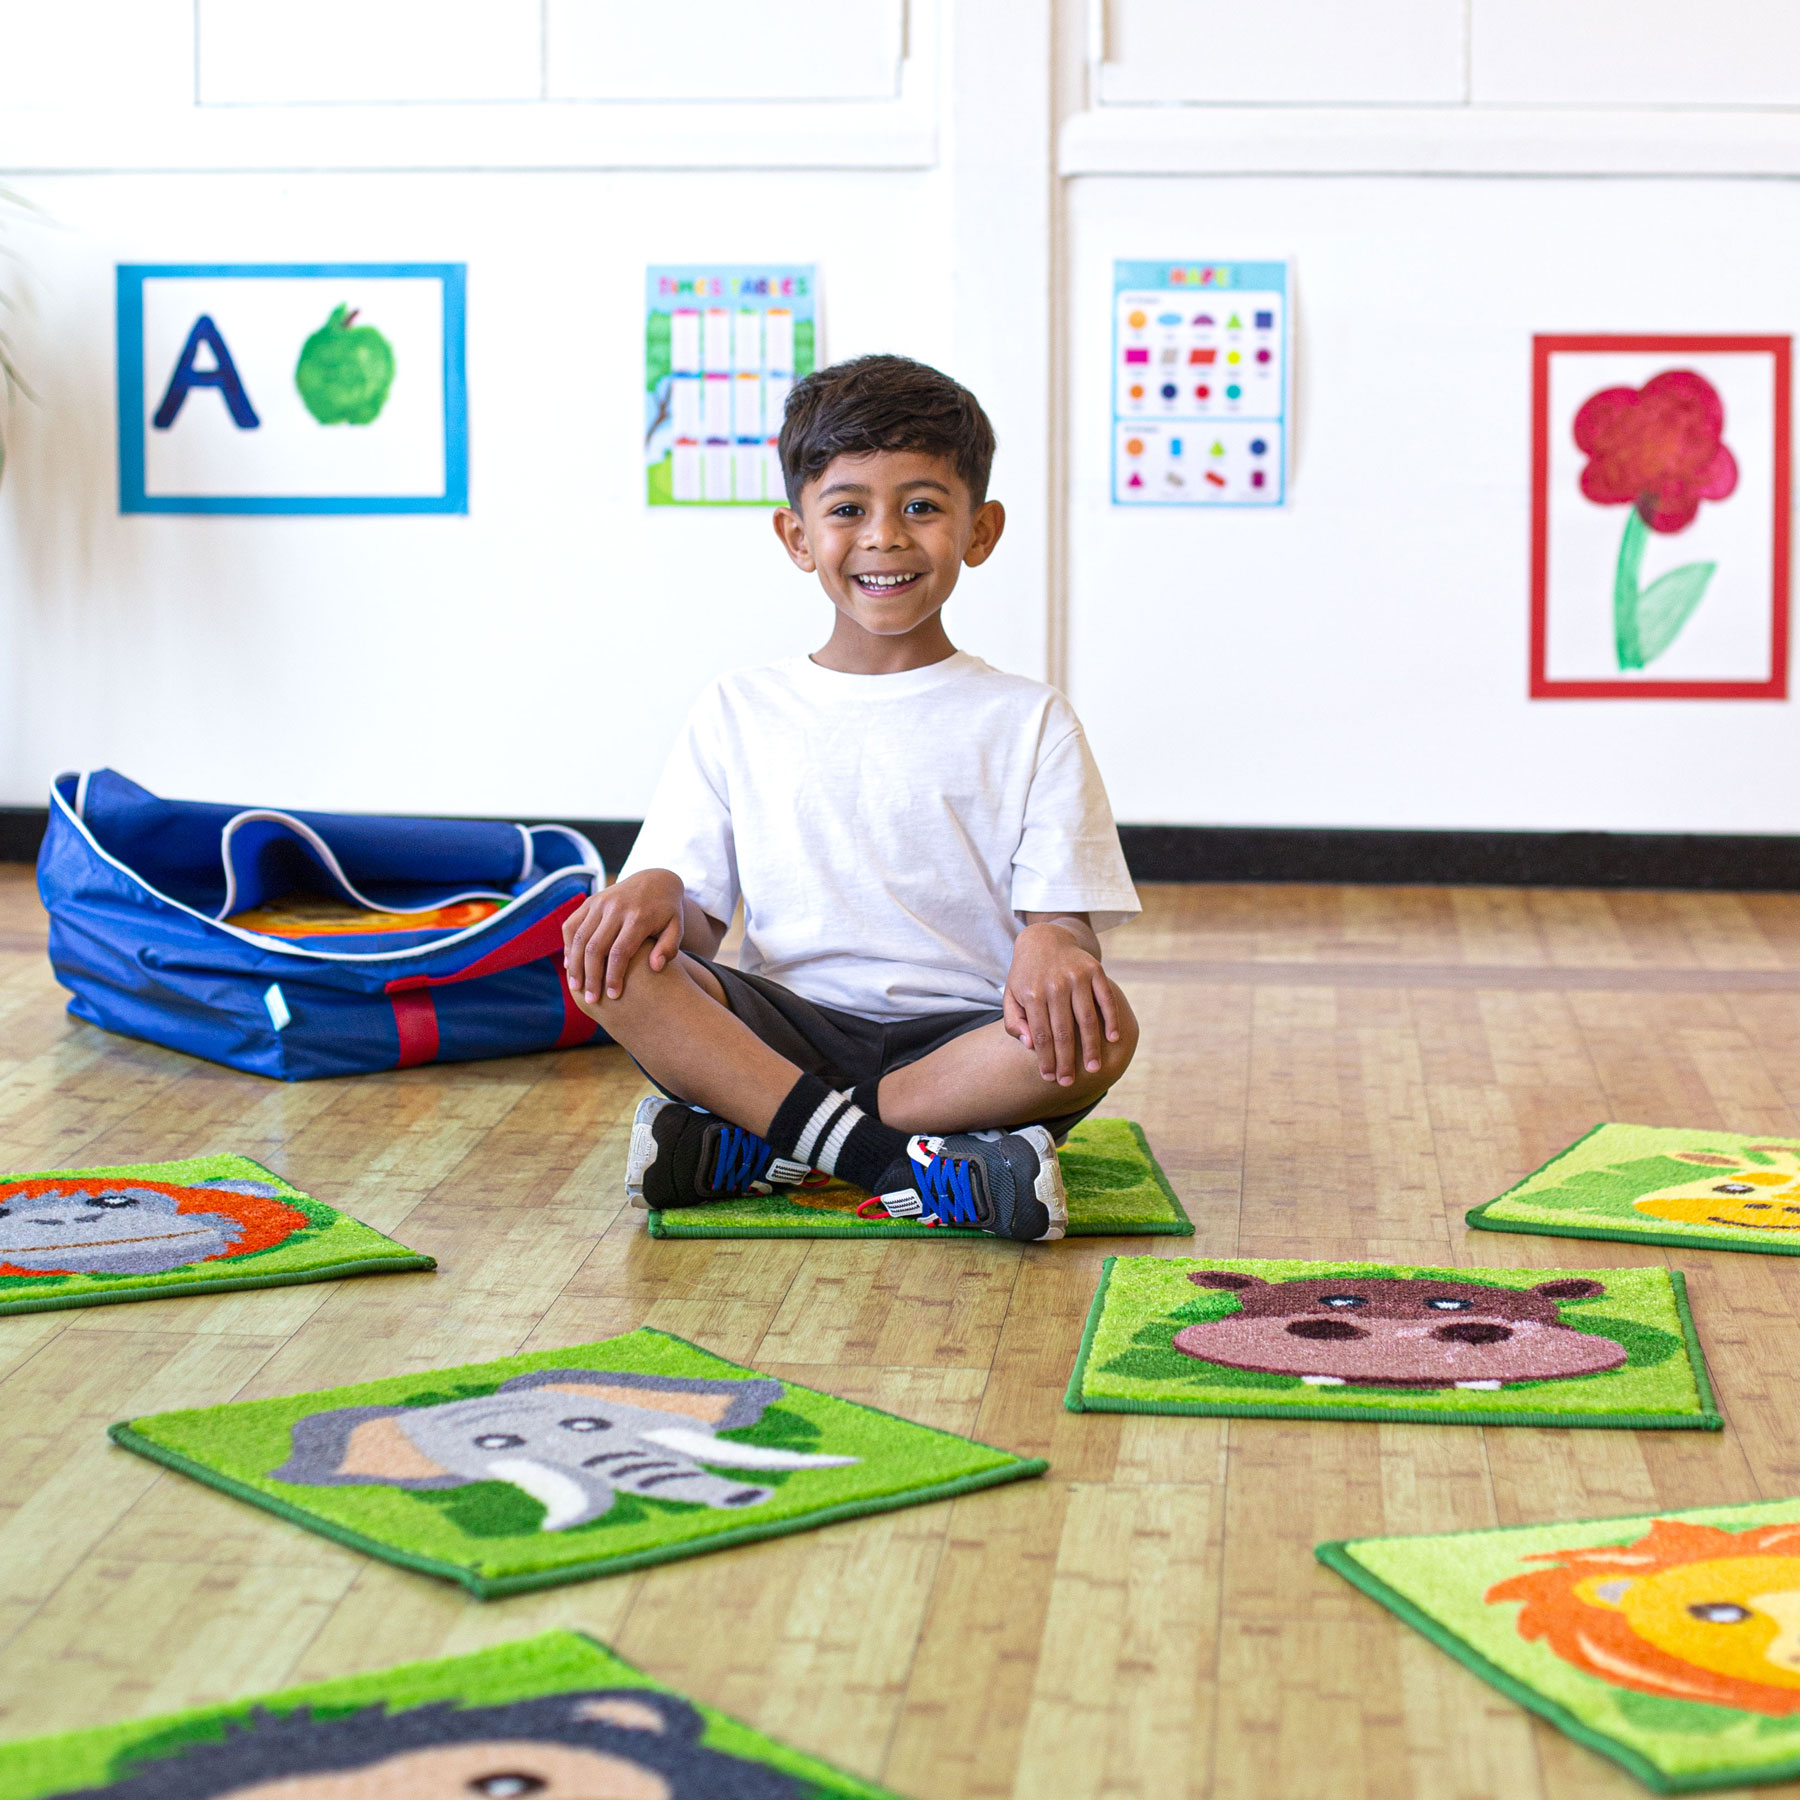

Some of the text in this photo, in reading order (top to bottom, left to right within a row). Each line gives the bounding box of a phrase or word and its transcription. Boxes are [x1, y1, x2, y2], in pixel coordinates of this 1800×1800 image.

[658, 275, 808, 297] TIMES TABLES
[153, 313, 261, 431] A
